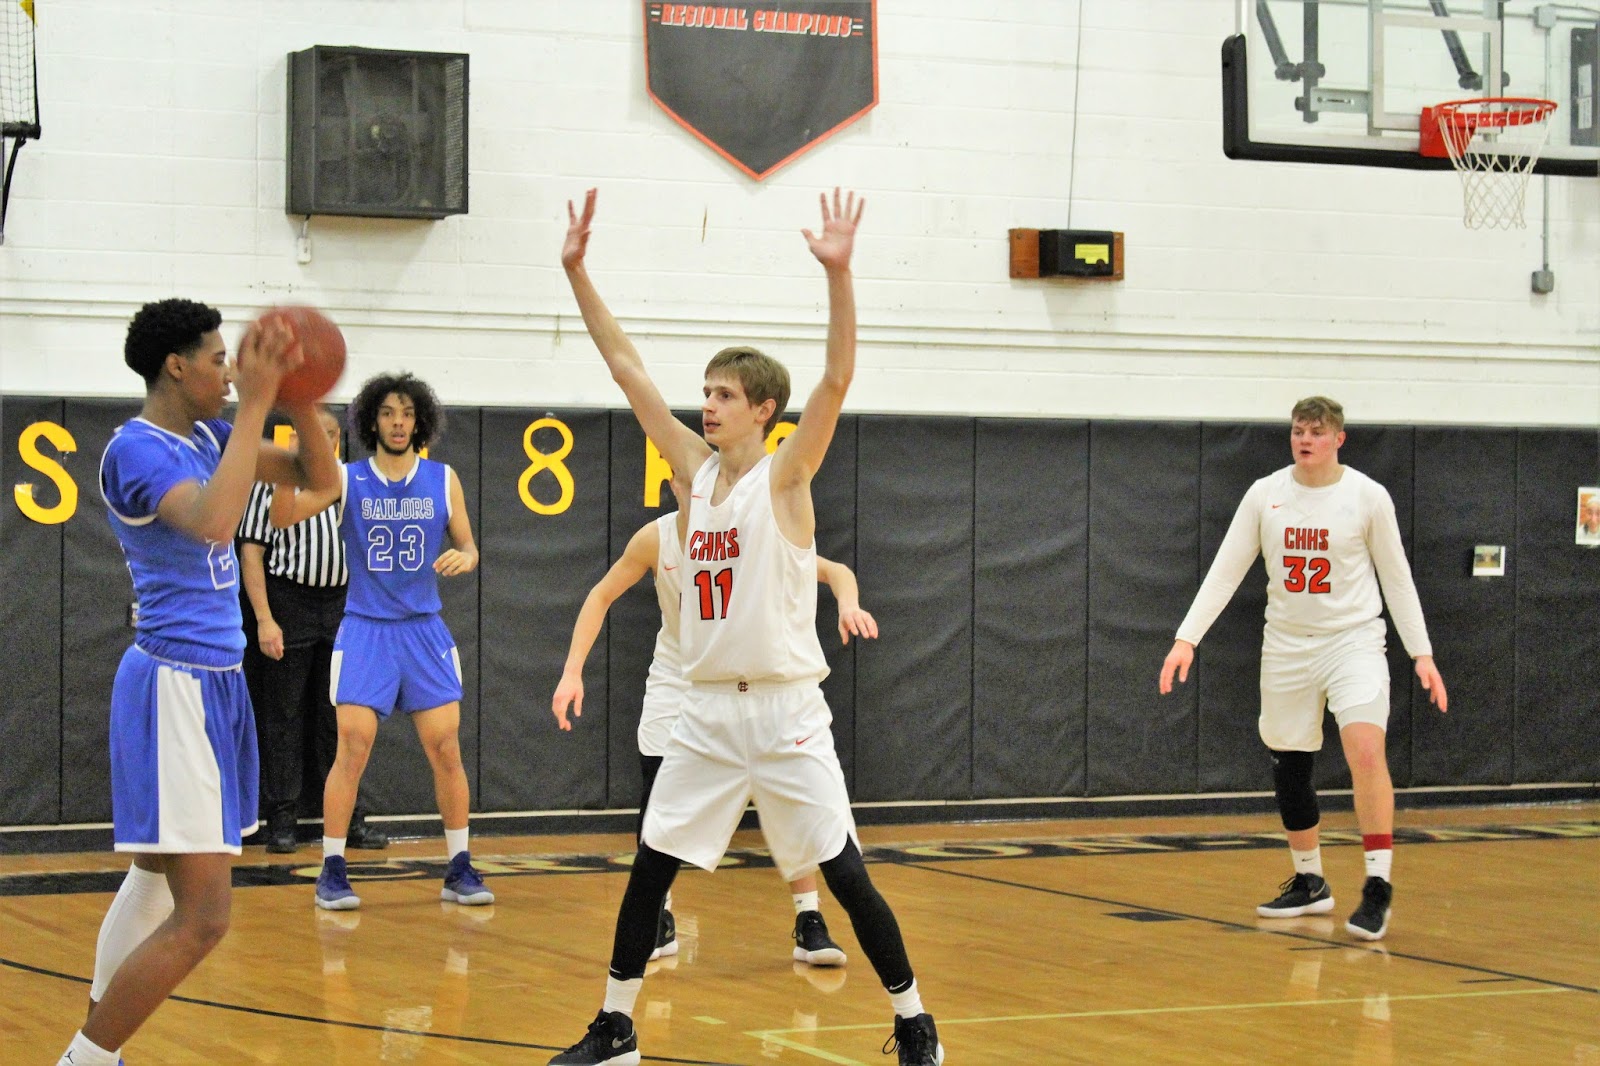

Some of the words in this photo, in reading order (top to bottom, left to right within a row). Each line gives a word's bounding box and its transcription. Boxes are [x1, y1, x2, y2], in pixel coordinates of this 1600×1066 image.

[661, 3, 748, 31] REGIONAL
[753, 9, 852, 37] CHAMPIONS
[361, 497, 434, 520] SAILORS
[367, 525, 425, 571] 23
[689, 527, 740, 562] CHHS
[1284, 527, 1329, 551] CHHS
[206, 538, 237, 590] 2
[1283, 555, 1331, 594] 32
[694, 567, 733, 620] 11
